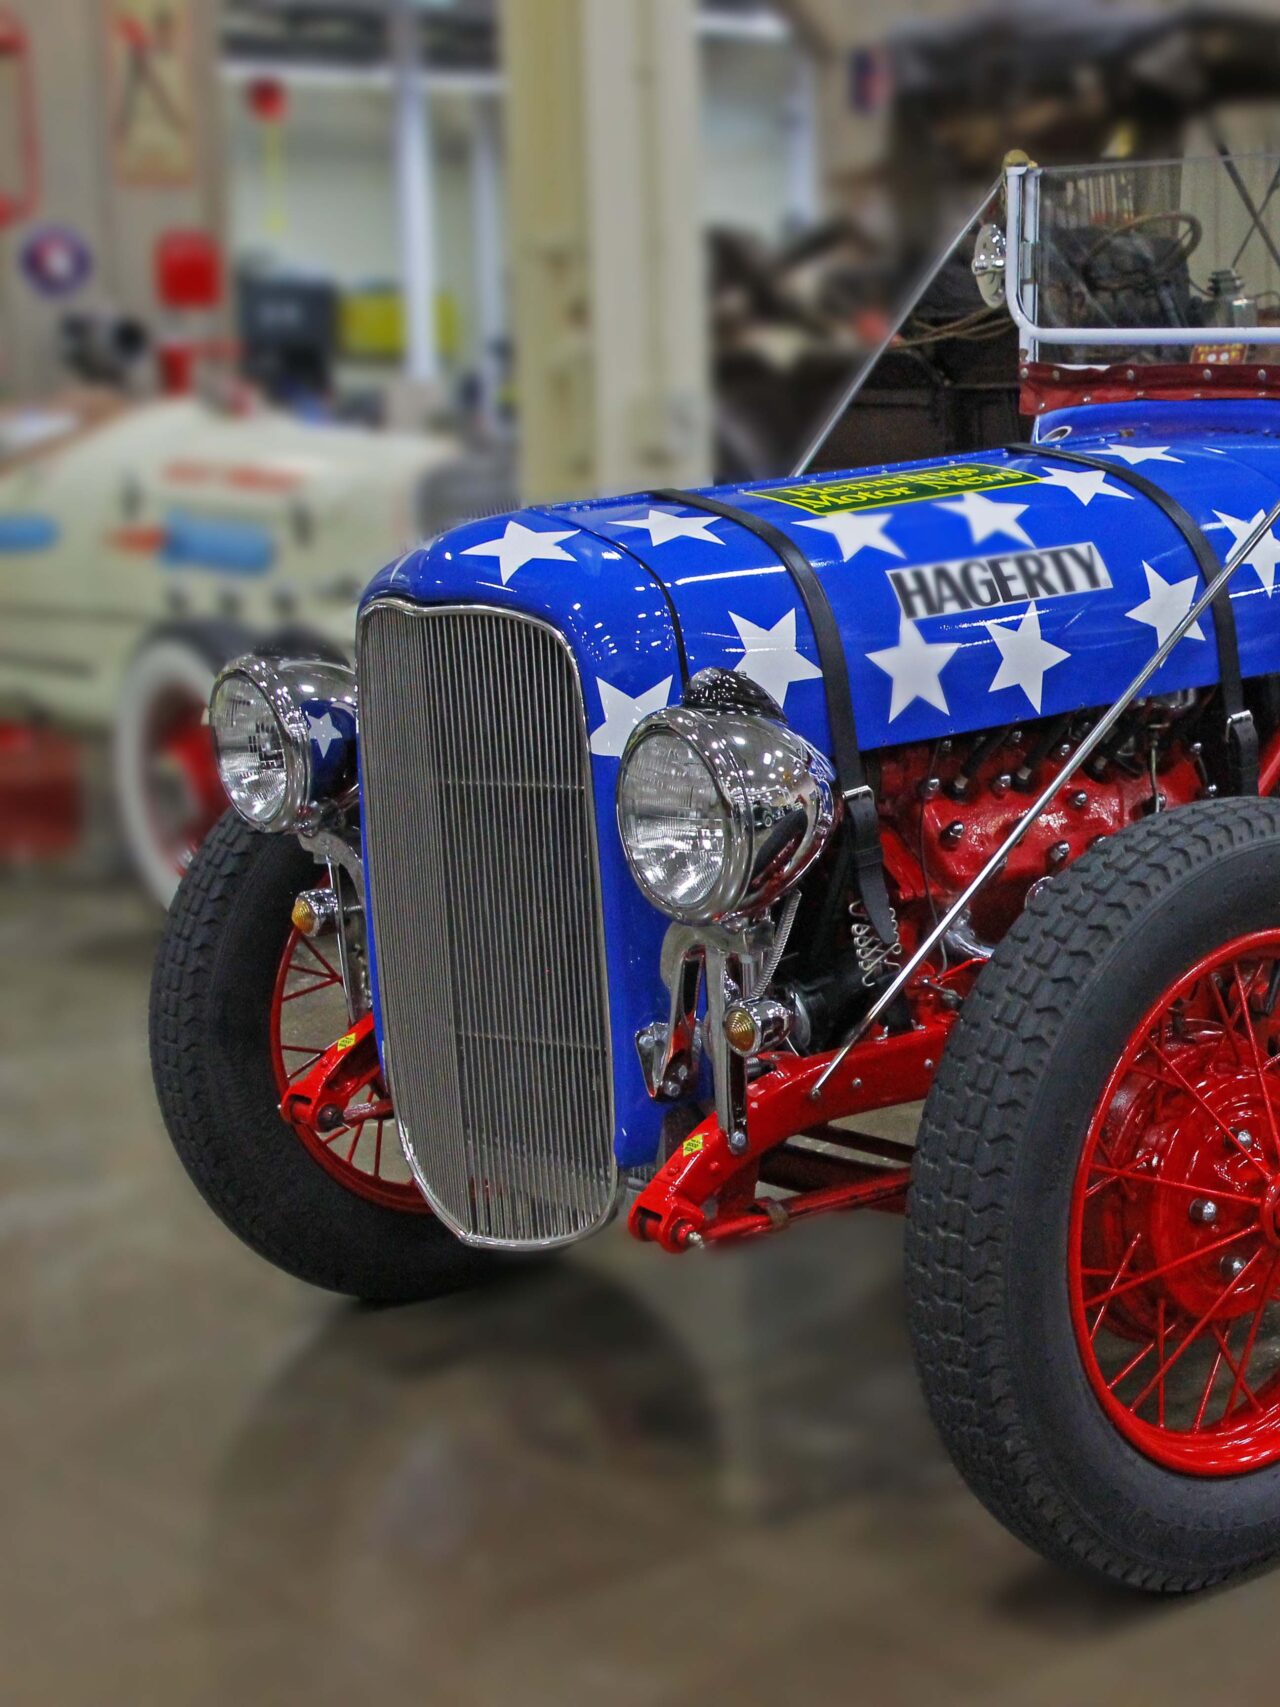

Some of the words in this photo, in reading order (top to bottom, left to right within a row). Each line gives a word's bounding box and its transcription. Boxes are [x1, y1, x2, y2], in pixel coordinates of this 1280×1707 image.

[782, 467, 980, 498] Hemmings
[789, 486, 916, 509] Motor
[914, 471, 1023, 490] News
[889, 544, 1101, 619] HAGERTY
